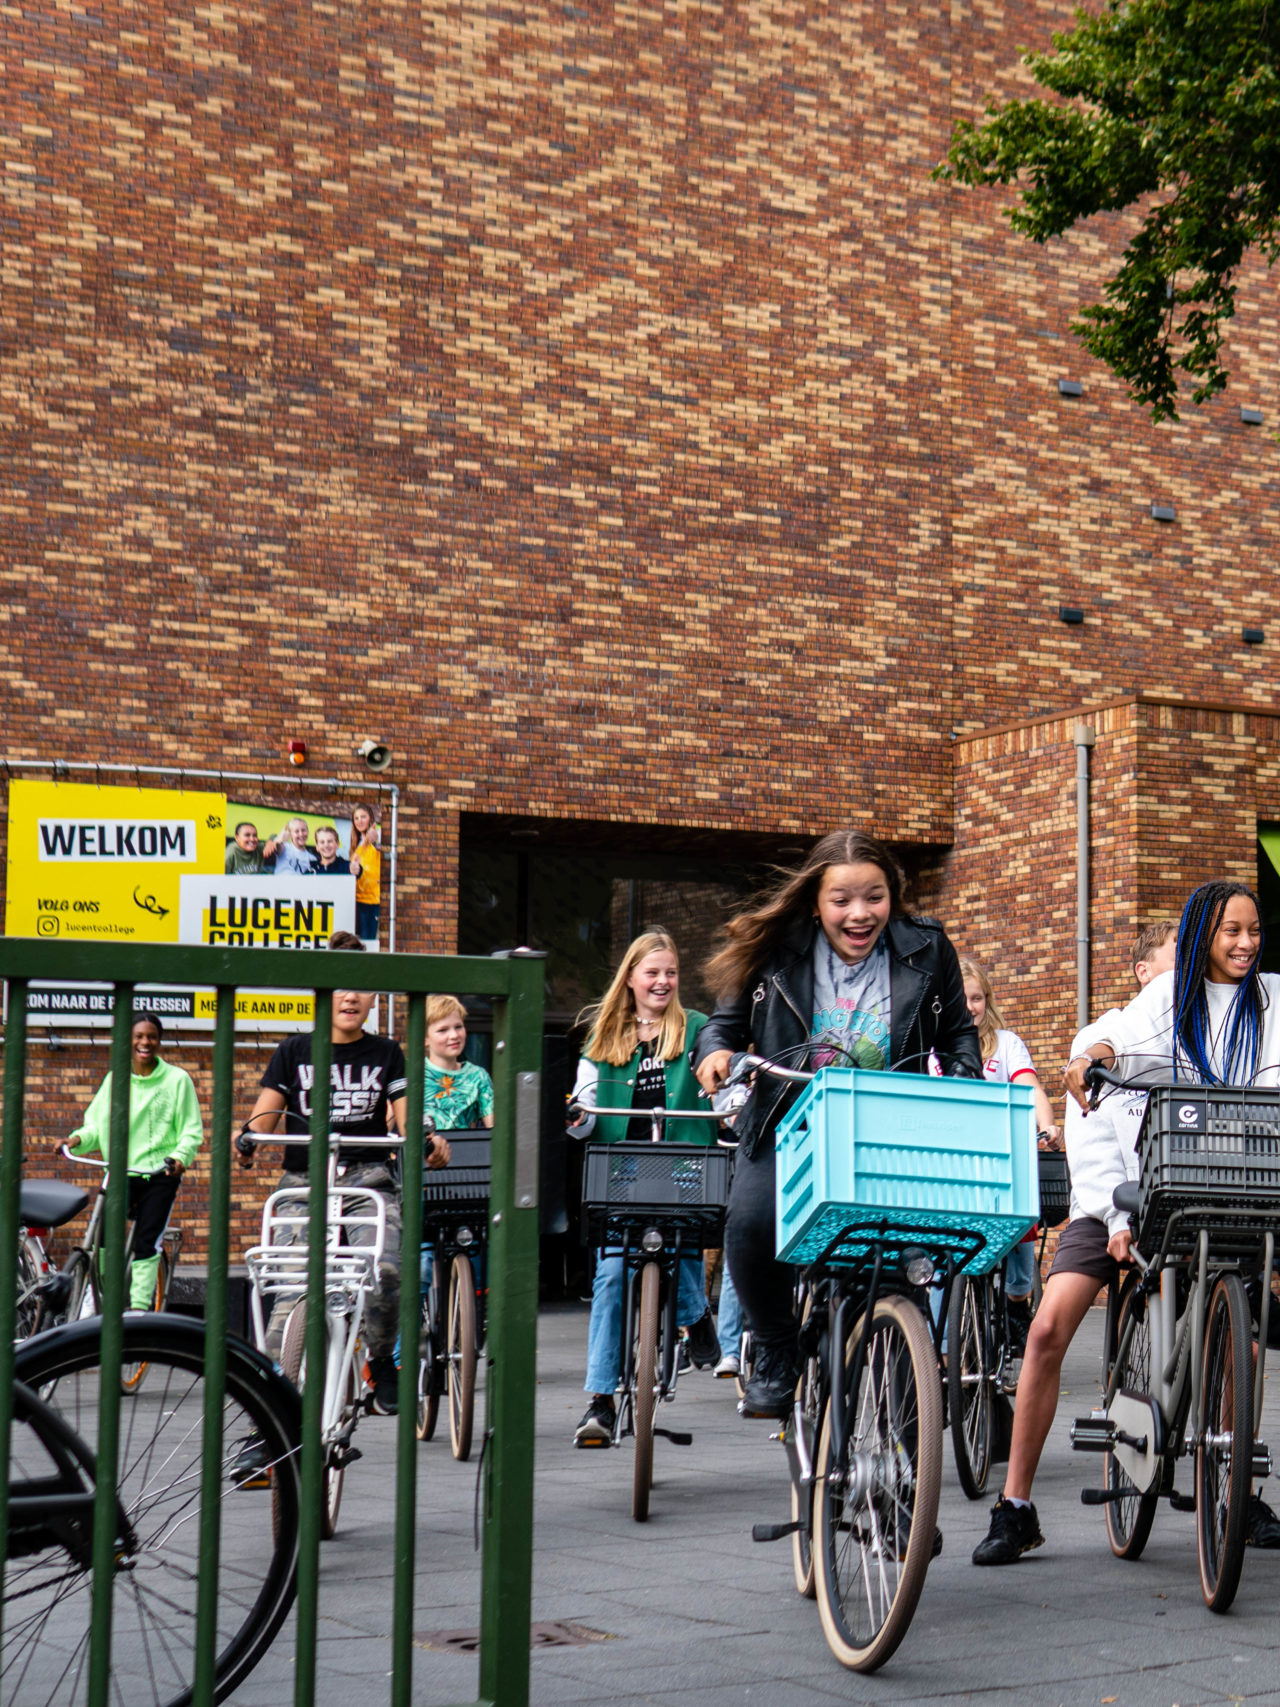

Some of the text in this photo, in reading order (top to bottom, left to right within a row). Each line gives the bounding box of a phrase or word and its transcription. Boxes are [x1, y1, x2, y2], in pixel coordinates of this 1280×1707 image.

[40, 824, 186, 857] WELKOM
[73, 900, 100, 913] ONS
[209, 895, 335, 932] LUCENT
[66, 922, 136, 936] lucentcollege
[51, 994, 87, 1010] NAAR
[90, 996, 106, 1010] DE
[251, 1001, 276, 1014] AAN
[279, 1002, 294, 1015] OP
[297, 1003, 311, 1015] DE
[298, 1064, 383, 1091] WALK
[298, 1091, 371, 1116] LSS
